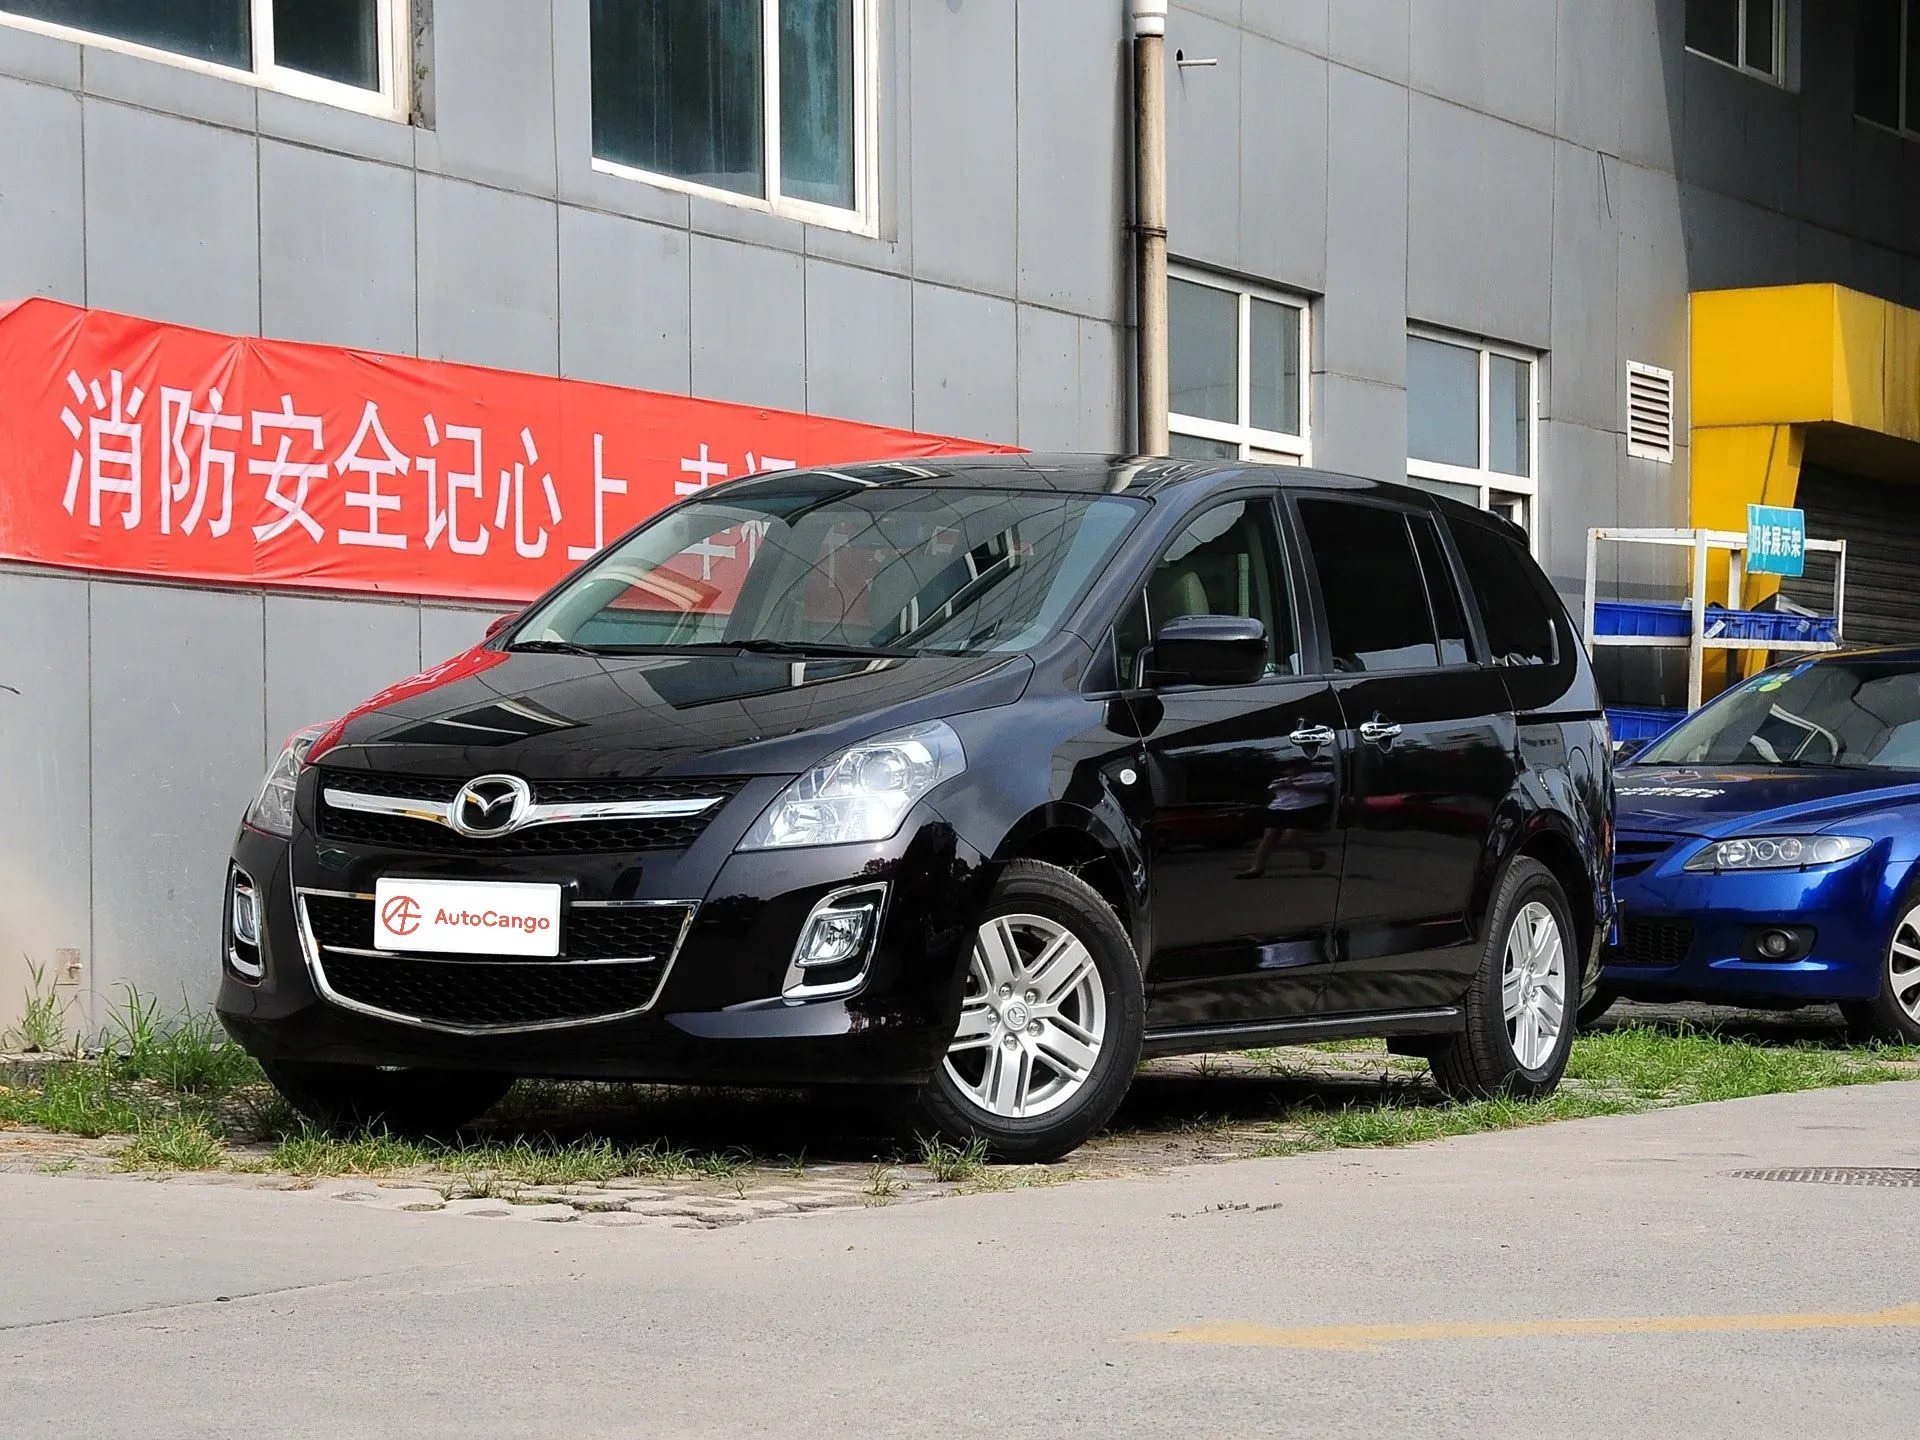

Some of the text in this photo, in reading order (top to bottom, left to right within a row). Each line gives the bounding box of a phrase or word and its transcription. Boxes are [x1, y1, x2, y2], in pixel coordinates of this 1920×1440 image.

[59, 368, 628, 561] 消防安全记心上
